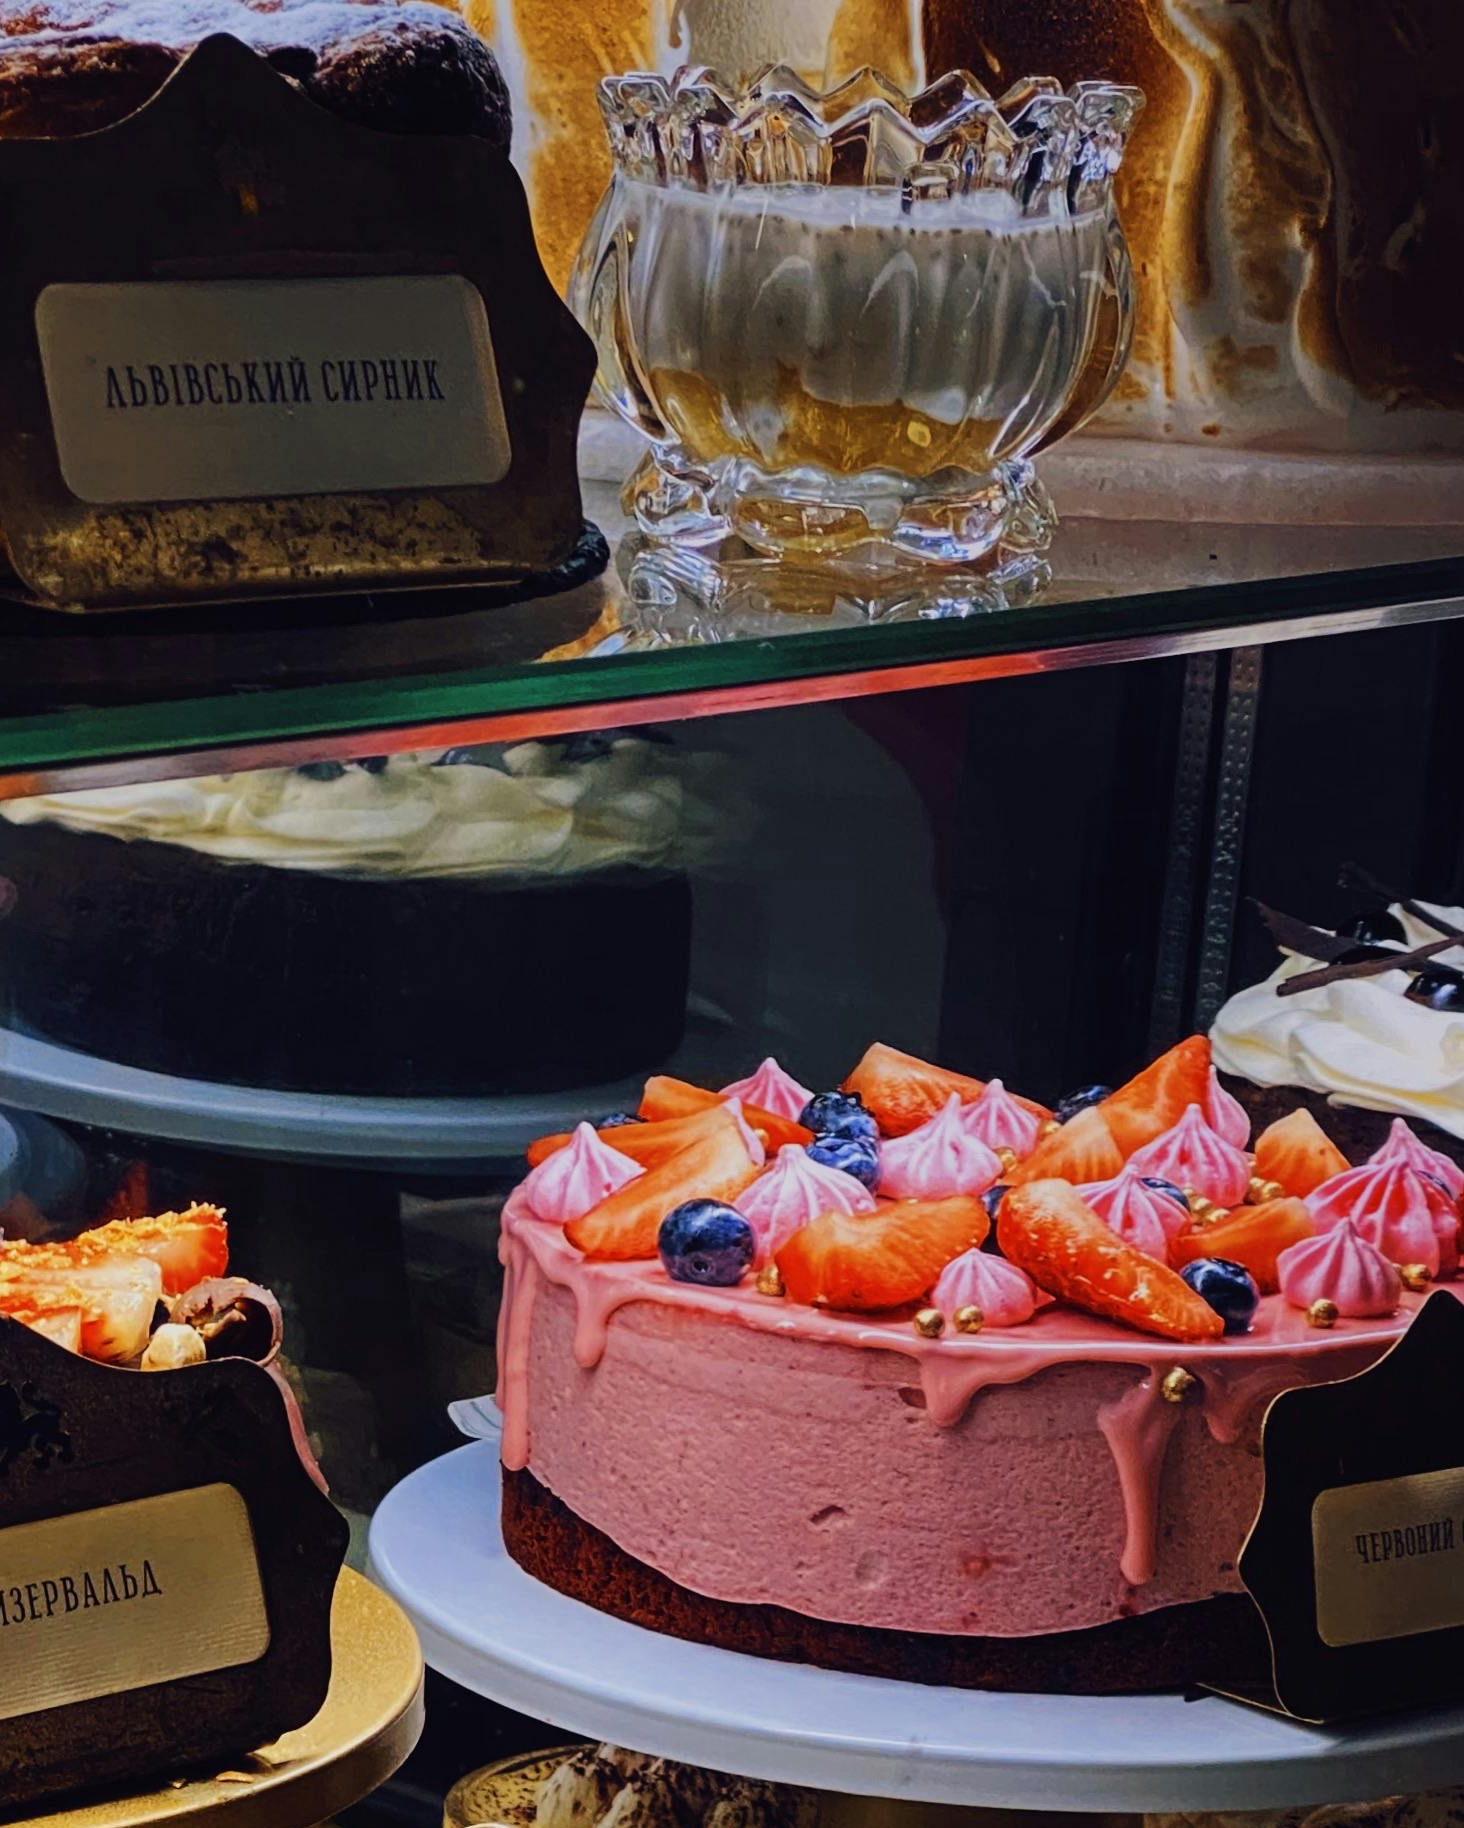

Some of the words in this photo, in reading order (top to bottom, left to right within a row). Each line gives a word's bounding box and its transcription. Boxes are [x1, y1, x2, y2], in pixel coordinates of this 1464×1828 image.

[106, 356, 311, 408] ЛЬВІВСЬКИЙ
[320, 359, 445, 402] СИРНИК
[1355, 1518, 1454, 1564] ЧЕРВОНИЙ
